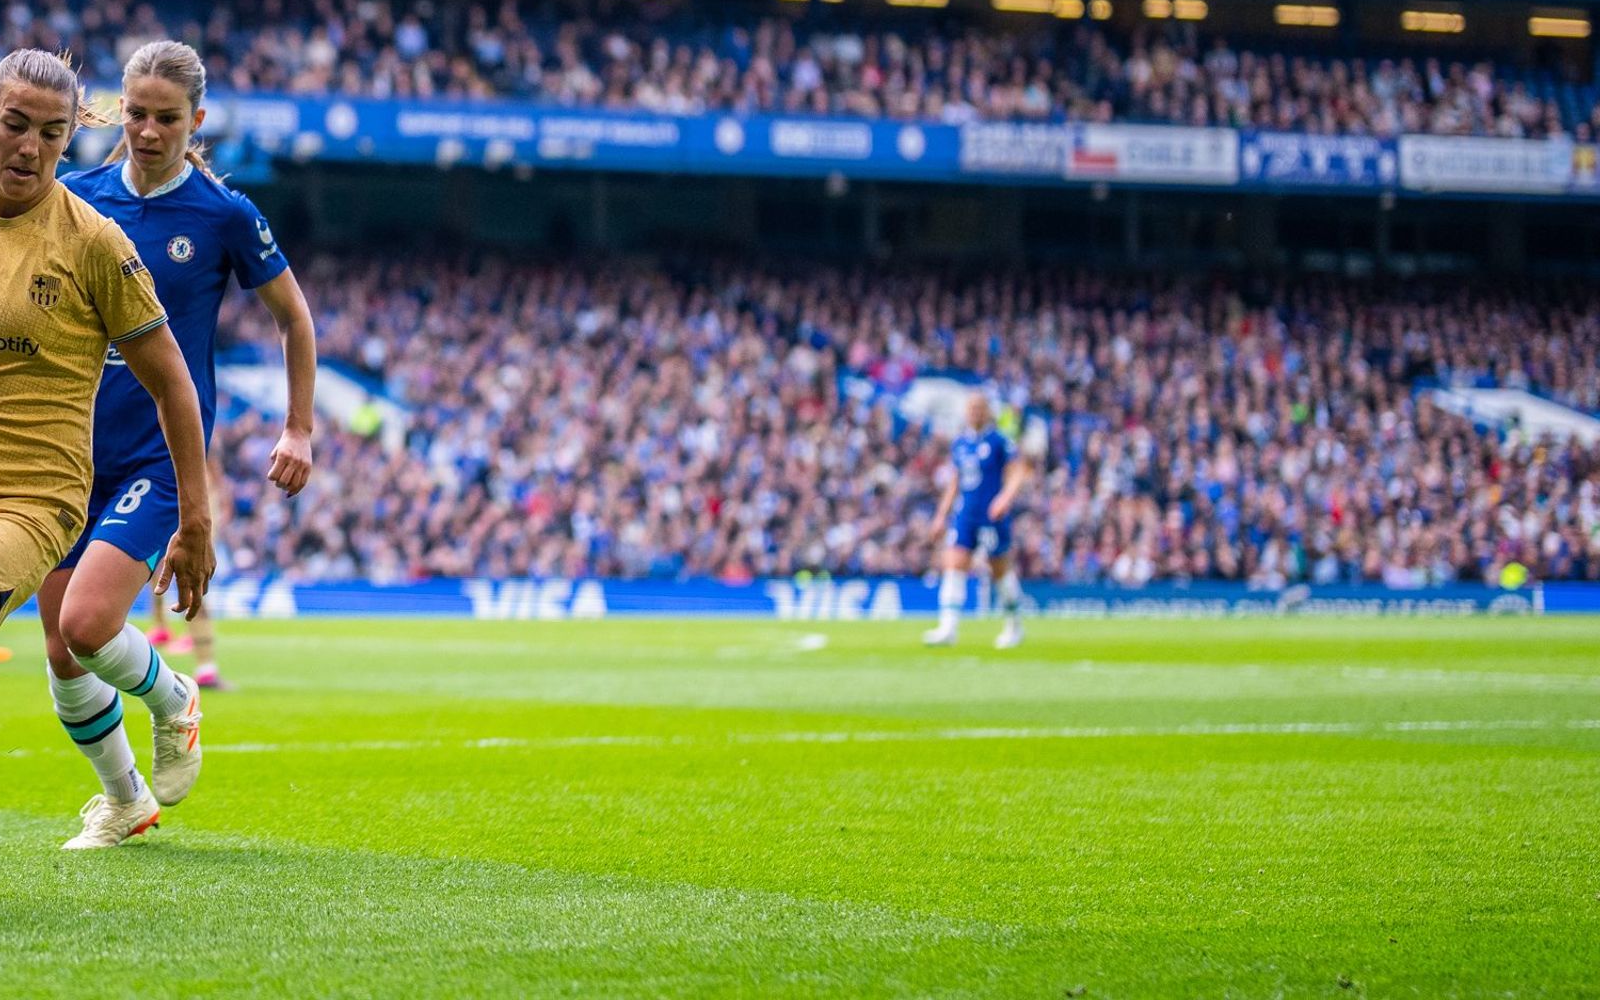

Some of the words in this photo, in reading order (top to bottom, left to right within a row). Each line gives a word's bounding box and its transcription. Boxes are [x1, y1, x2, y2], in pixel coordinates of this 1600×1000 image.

[113, 478, 151, 514] 8
[461, 577, 608, 620] VISA
[766, 579, 901, 621] VISA
